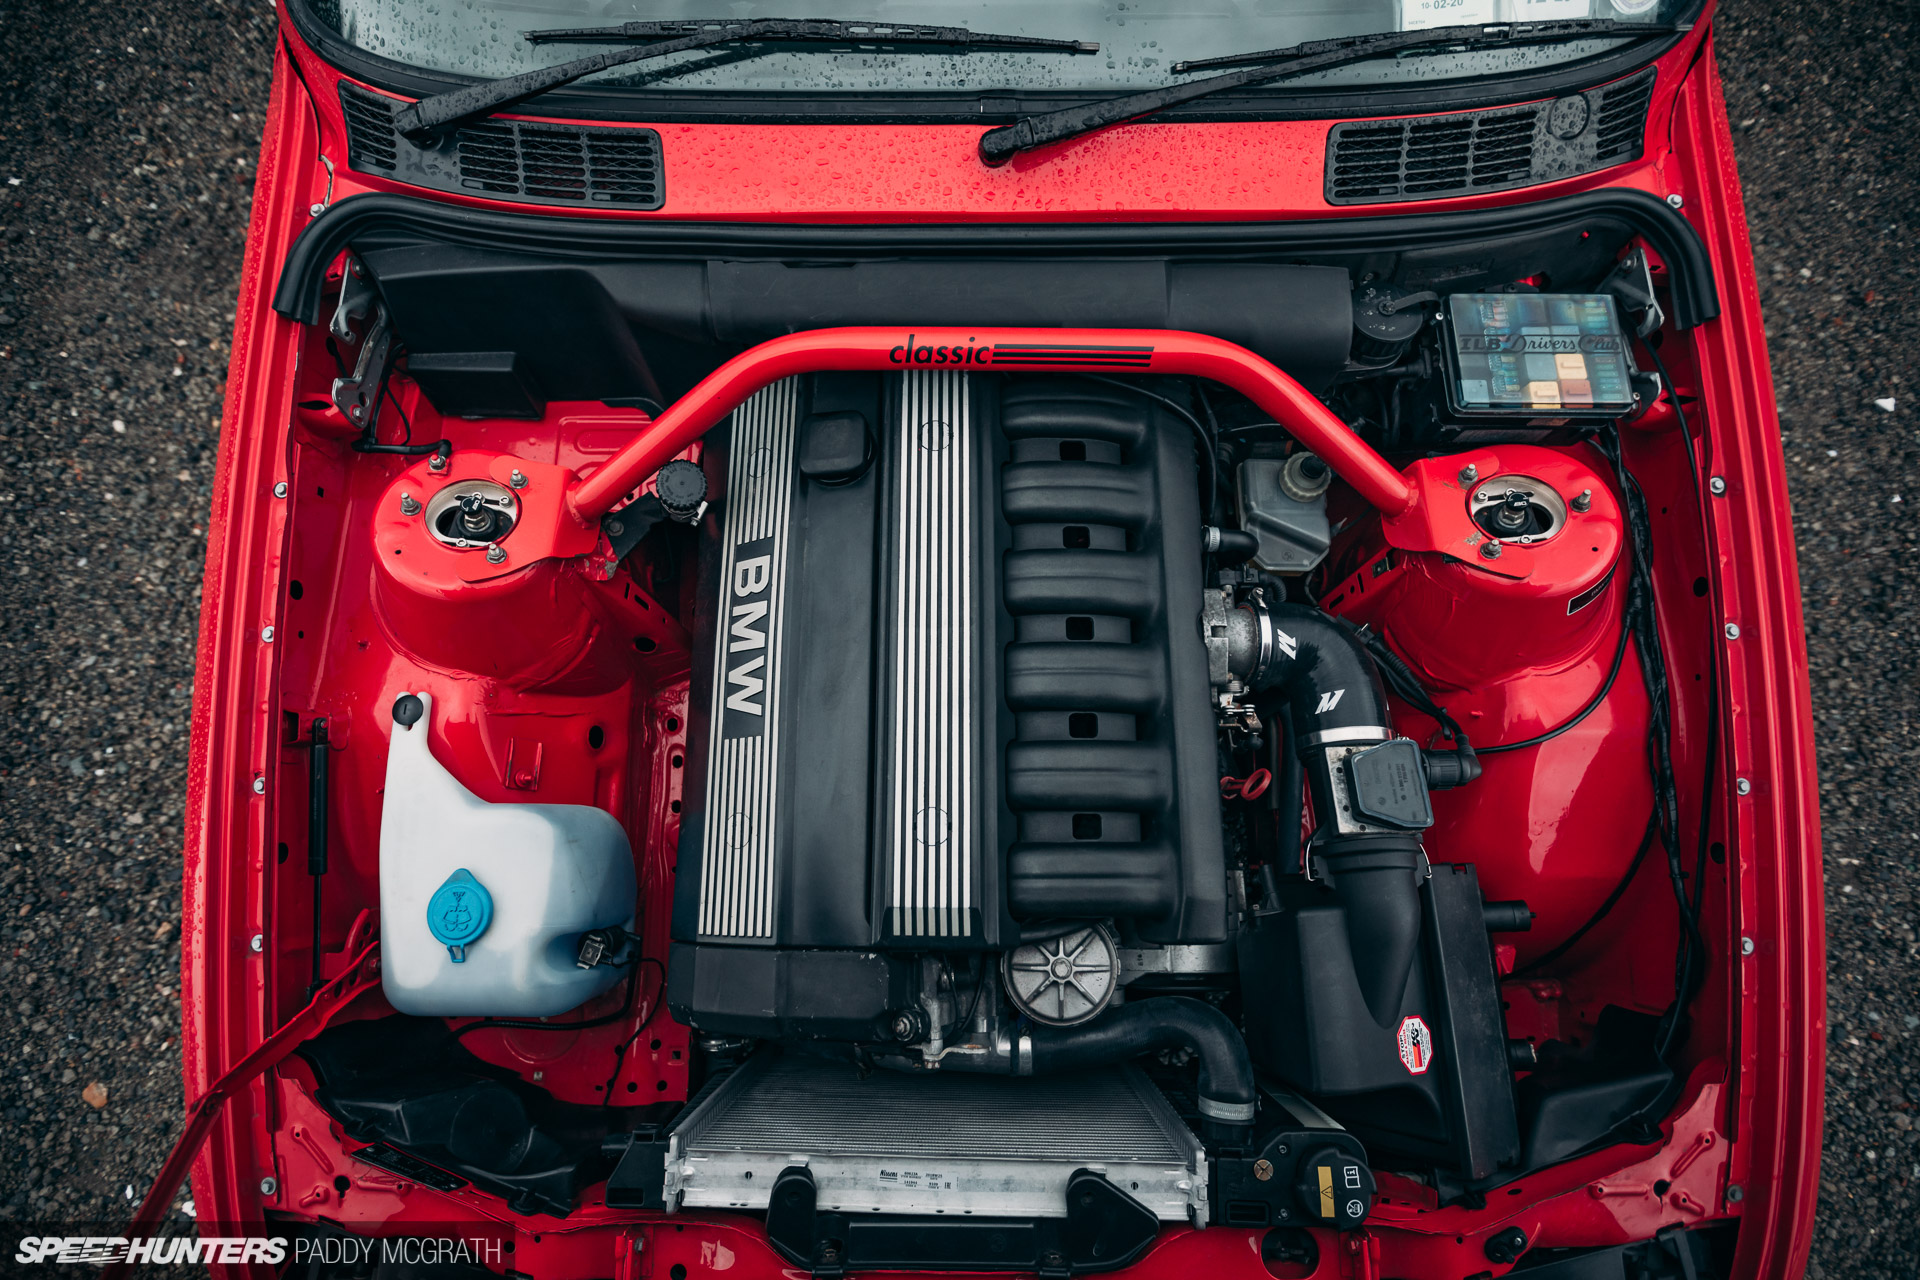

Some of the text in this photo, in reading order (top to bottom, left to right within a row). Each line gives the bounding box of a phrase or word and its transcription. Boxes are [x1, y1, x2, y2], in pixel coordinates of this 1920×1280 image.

[1434, 0, 1463, 9] 02-20
[889, 334, 990, 364] classic
[1503, 335, 1576, 353] Drivers
[1579, 335, 1620, 353] Club
[727, 555, 771, 716] BMW
